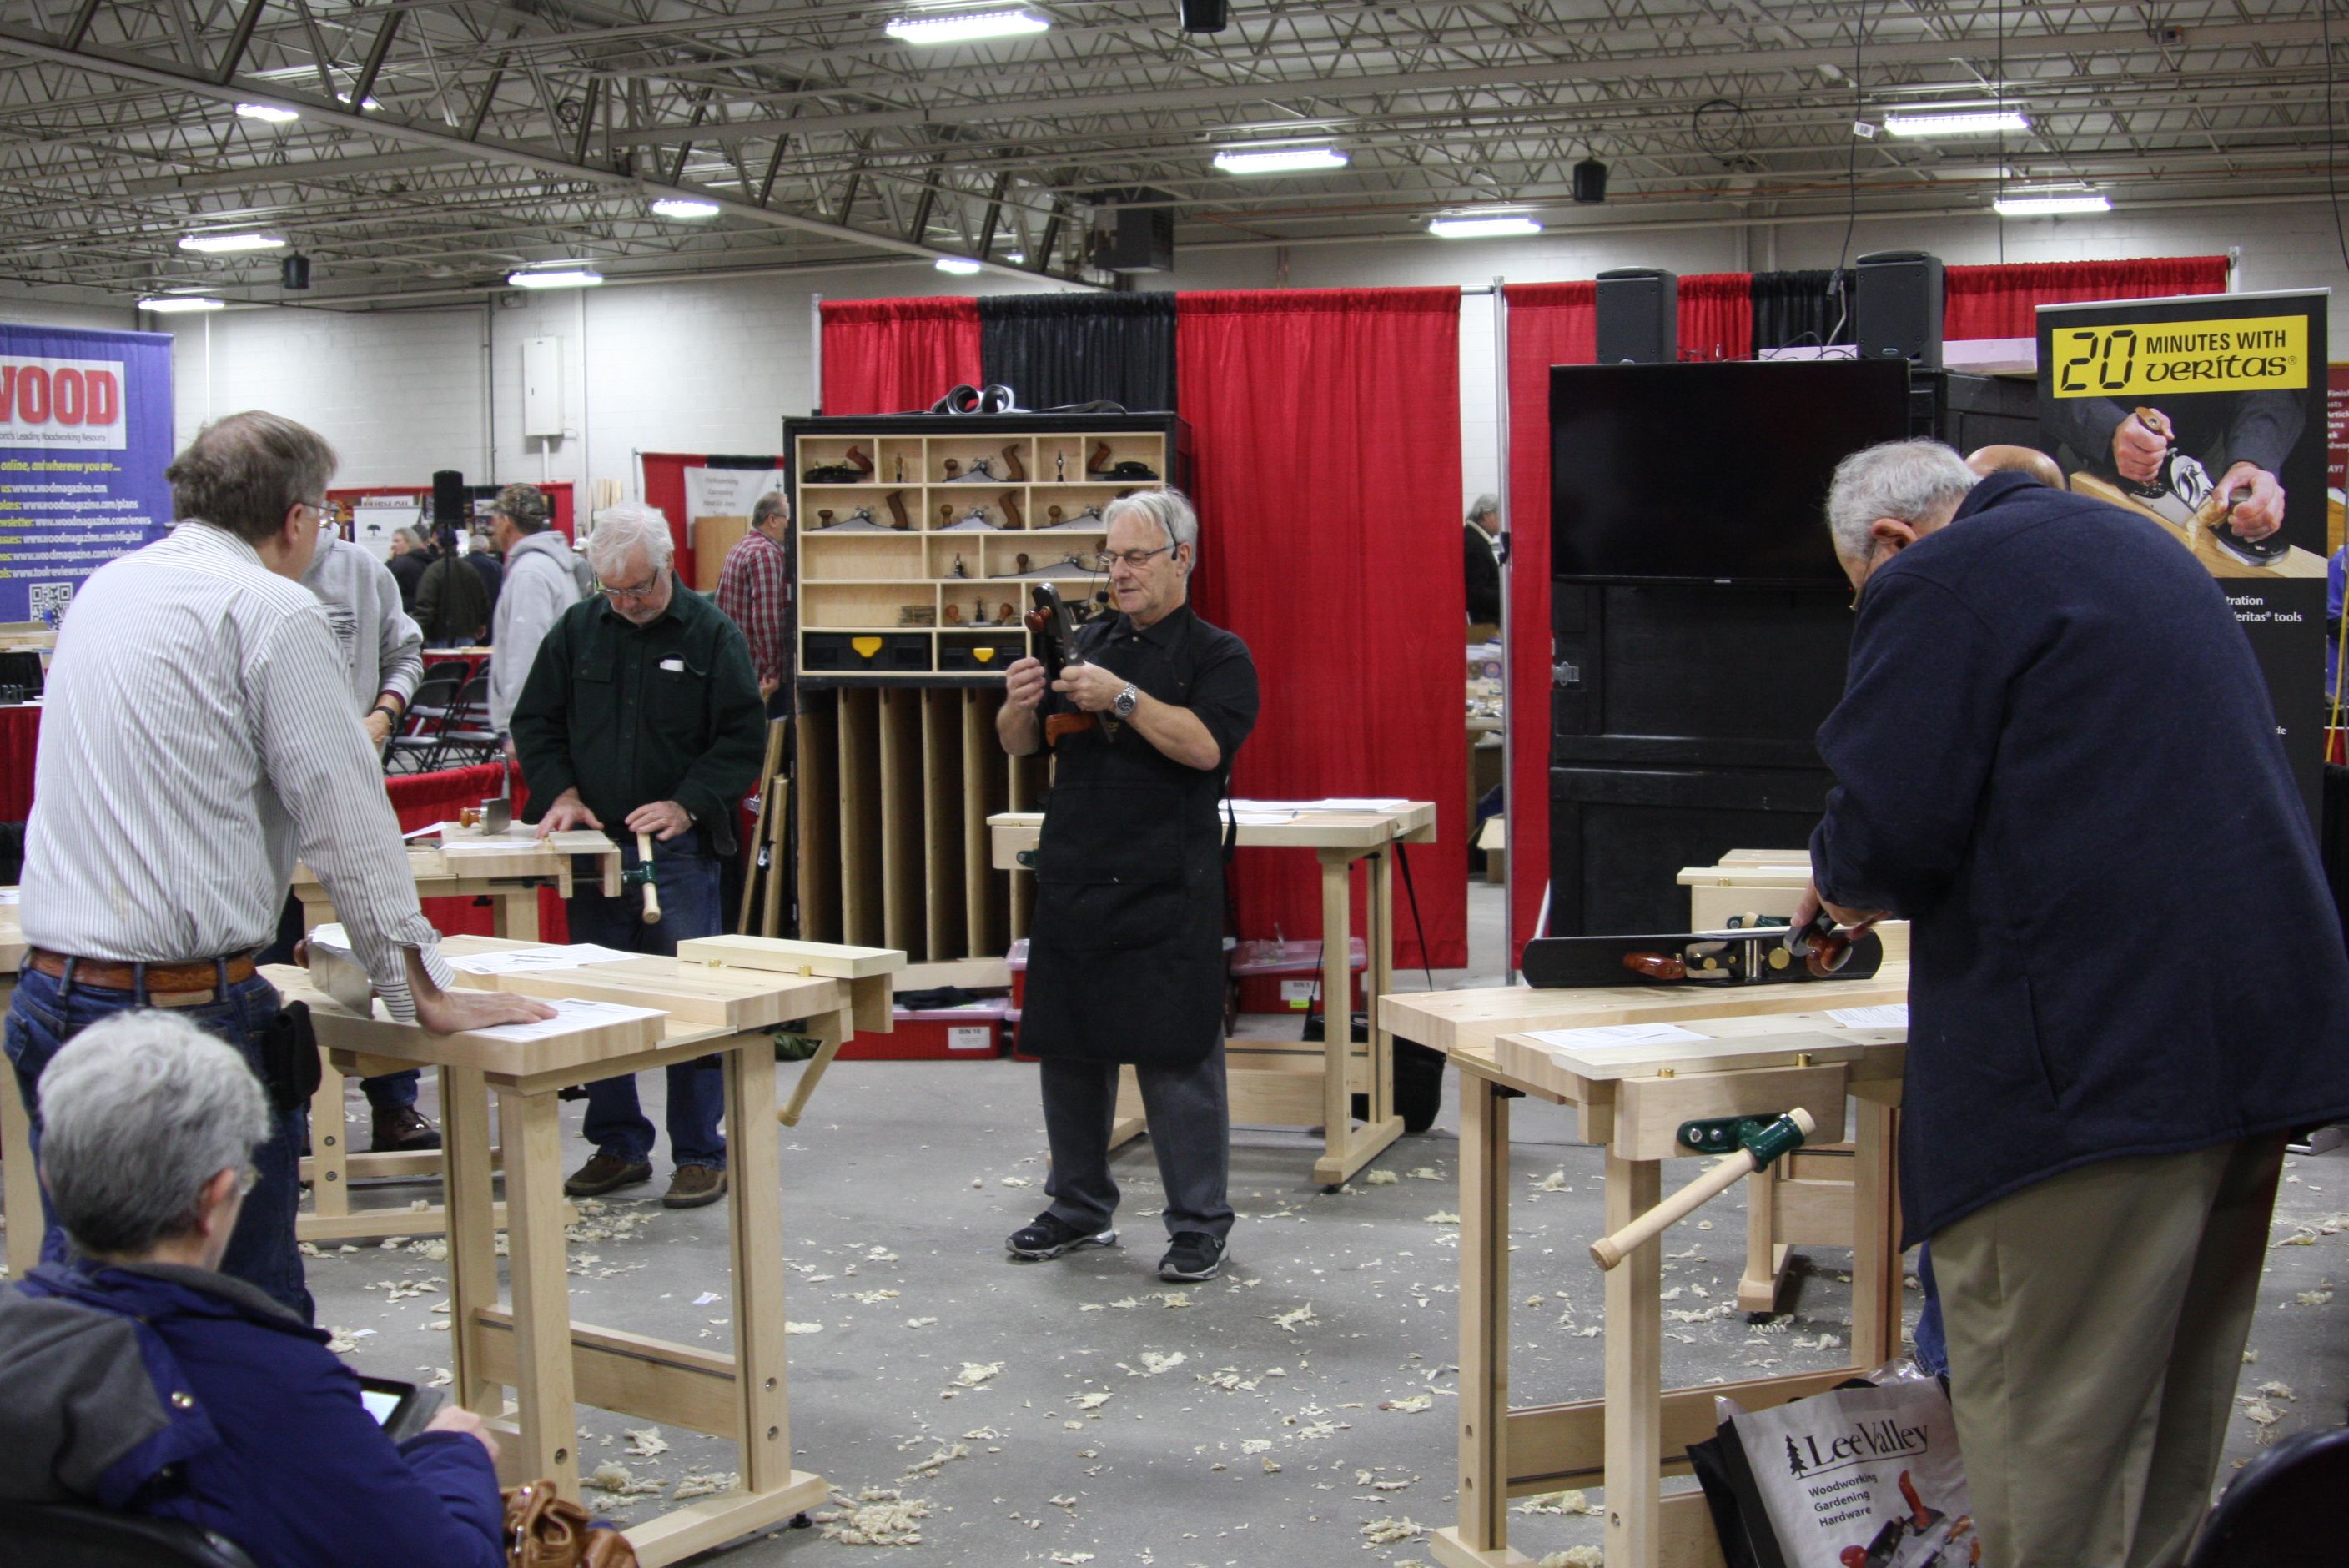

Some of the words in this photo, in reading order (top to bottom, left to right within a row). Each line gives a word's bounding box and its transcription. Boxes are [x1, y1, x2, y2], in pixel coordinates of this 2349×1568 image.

[2061, 330, 2137, 391] 20
[2146, 333, 2230, 354] MINUTES
[2236, 330, 2286, 349] WITH
[2274, 611, 2302, 622] tools
[1808, 1472, 1879, 1498] Woodworking
[1814, 1490, 1870, 1513] Gardening
[1818, 1505, 1872, 1528] Hardware
